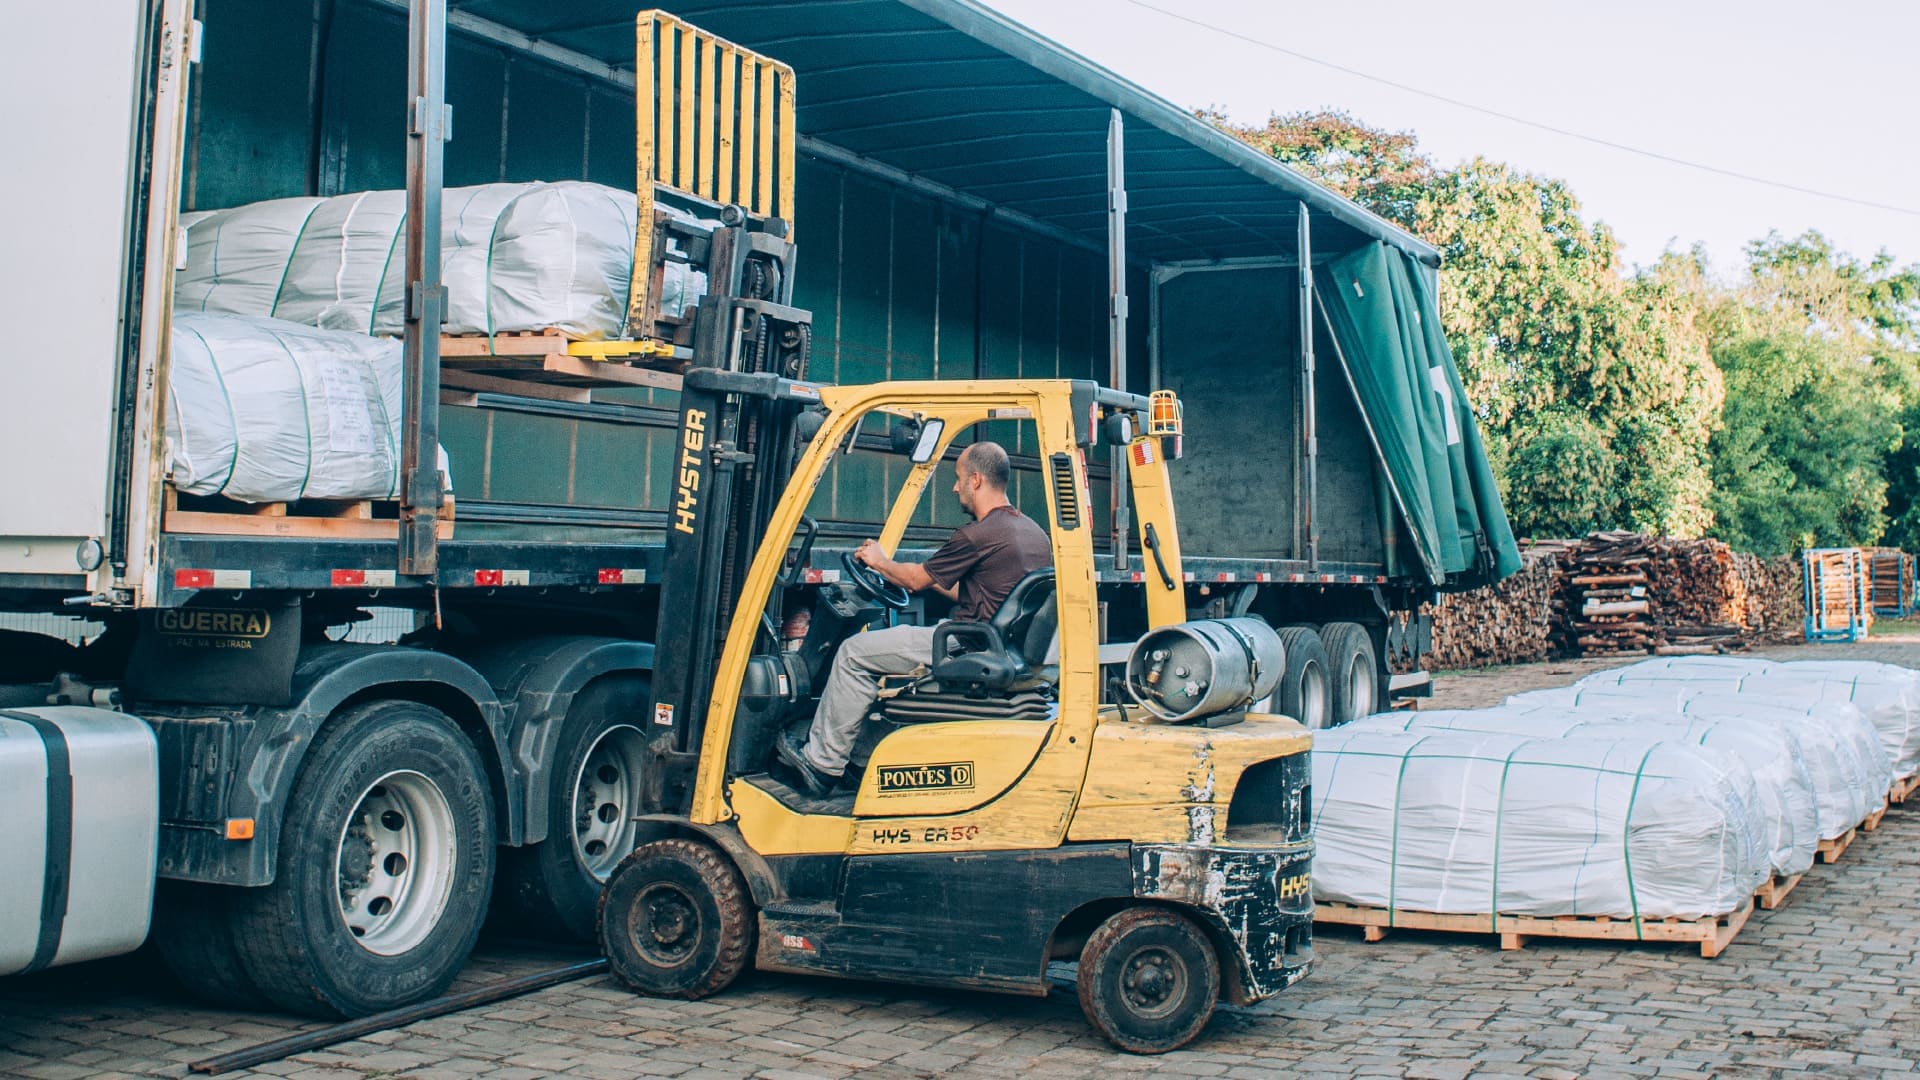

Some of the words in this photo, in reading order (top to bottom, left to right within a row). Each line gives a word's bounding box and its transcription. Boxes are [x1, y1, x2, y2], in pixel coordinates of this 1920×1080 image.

[675, 408, 706, 535] HYSTER
[162, 610, 262, 633] GUERRA
[882, 768, 946, 787] PONTES
[873, 827, 948, 844] HYSER
